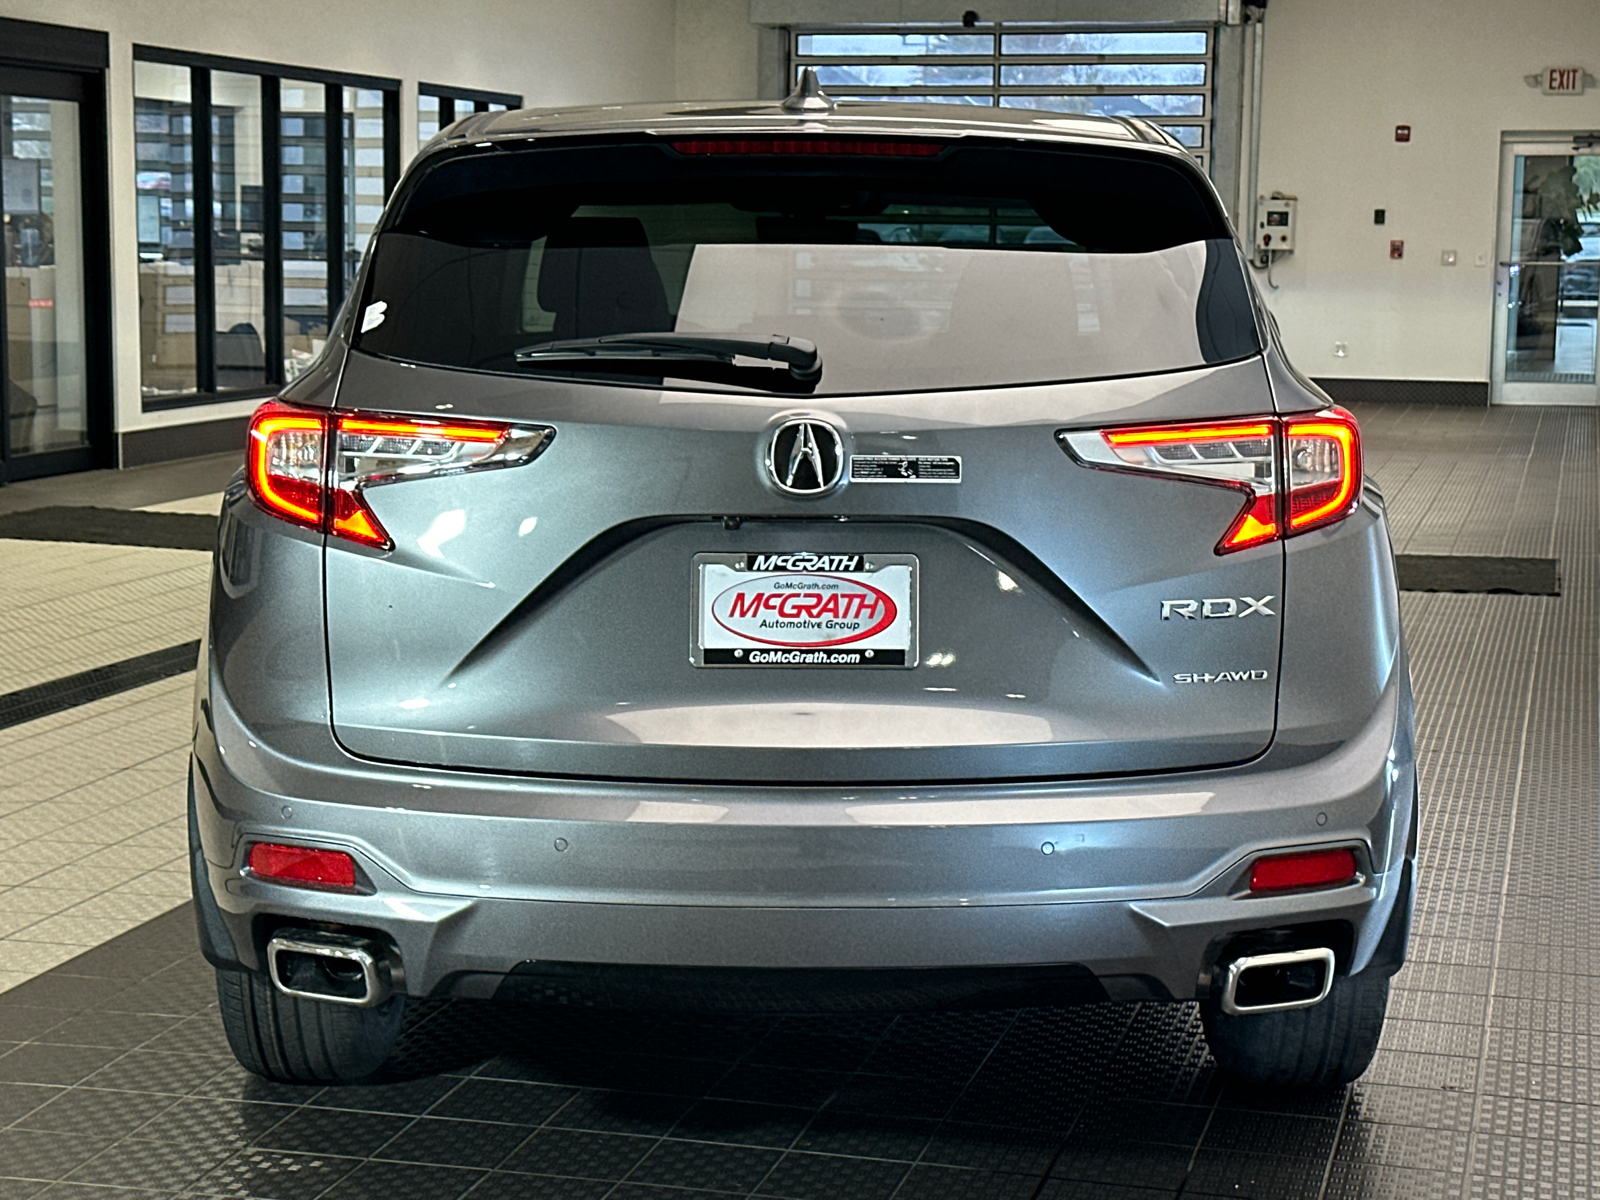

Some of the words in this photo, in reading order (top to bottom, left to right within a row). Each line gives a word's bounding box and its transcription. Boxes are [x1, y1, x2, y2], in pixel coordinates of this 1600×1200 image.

[1549, 69, 1578, 90] EXIT
[773, 582, 839, 590] GoMcGrath.com
[1160, 595, 1276, 620] RDX
[759, 619, 823, 629] Automotive
[825, 620, 860, 631] Group
[749, 651, 860, 664] GoMcGrath.com
